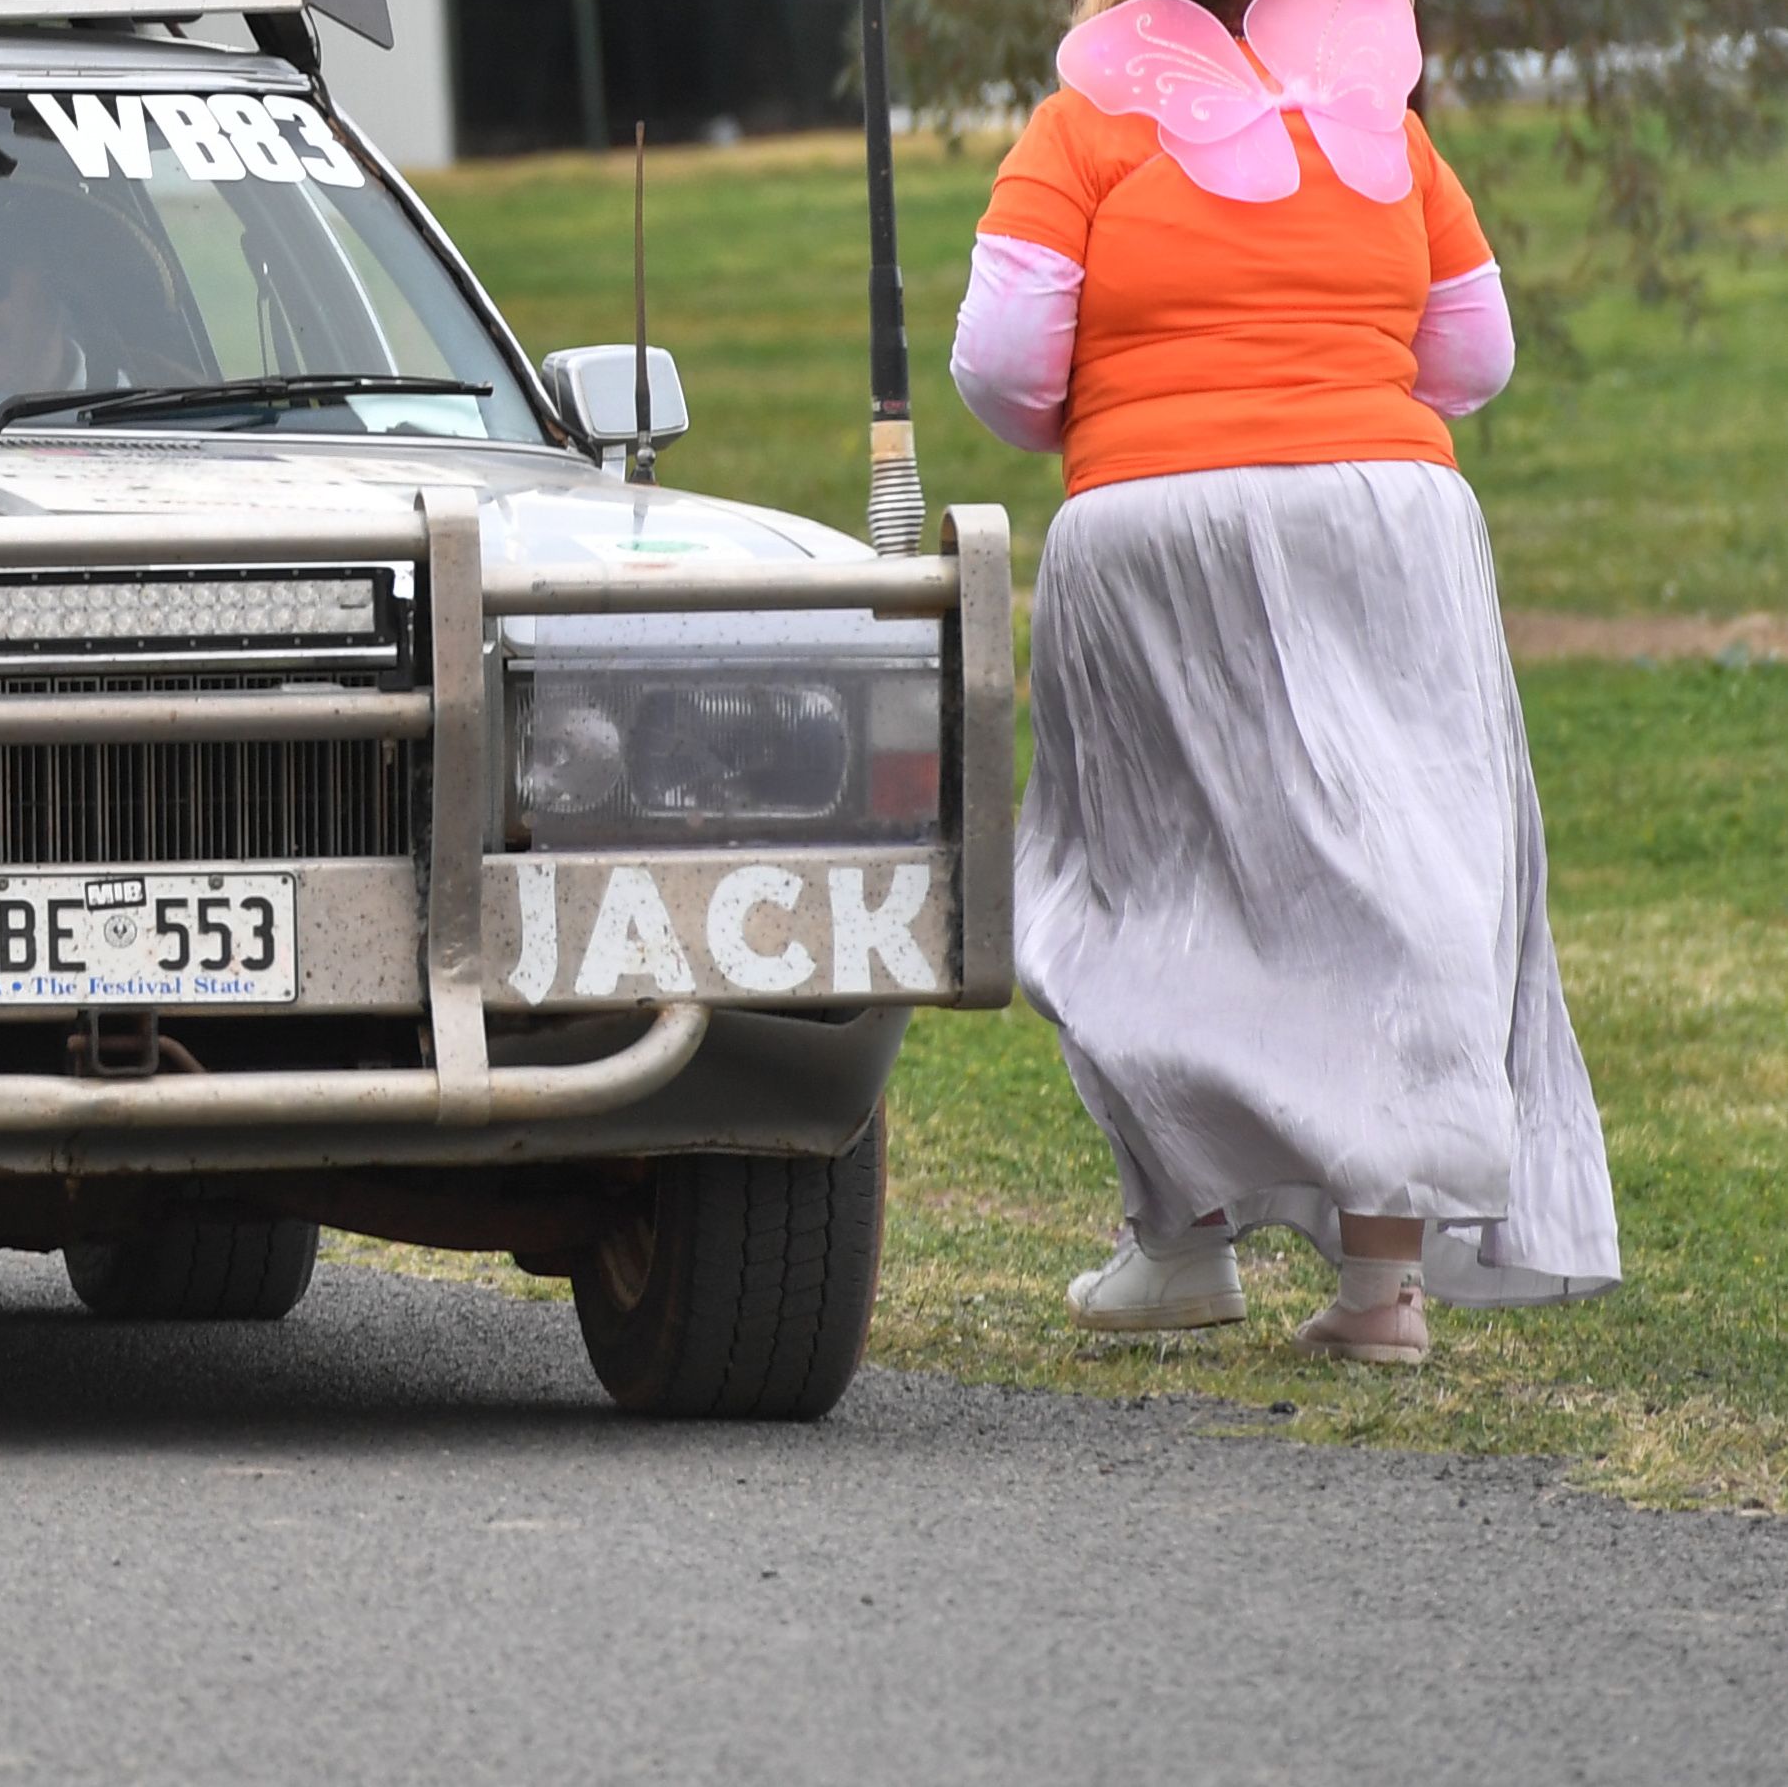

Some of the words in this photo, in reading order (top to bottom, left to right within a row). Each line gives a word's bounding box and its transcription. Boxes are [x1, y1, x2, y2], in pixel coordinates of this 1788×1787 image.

[28, 94, 365, 188] WB83
[87, 881, 145, 907] MIB
[155, 896, 276, 972] 553
[508, 861, 937, 1005] JACK
[31, 976, 78, 996] The
[88, 975, 183, 996] Festival
[194, 975, 256, 995] State
